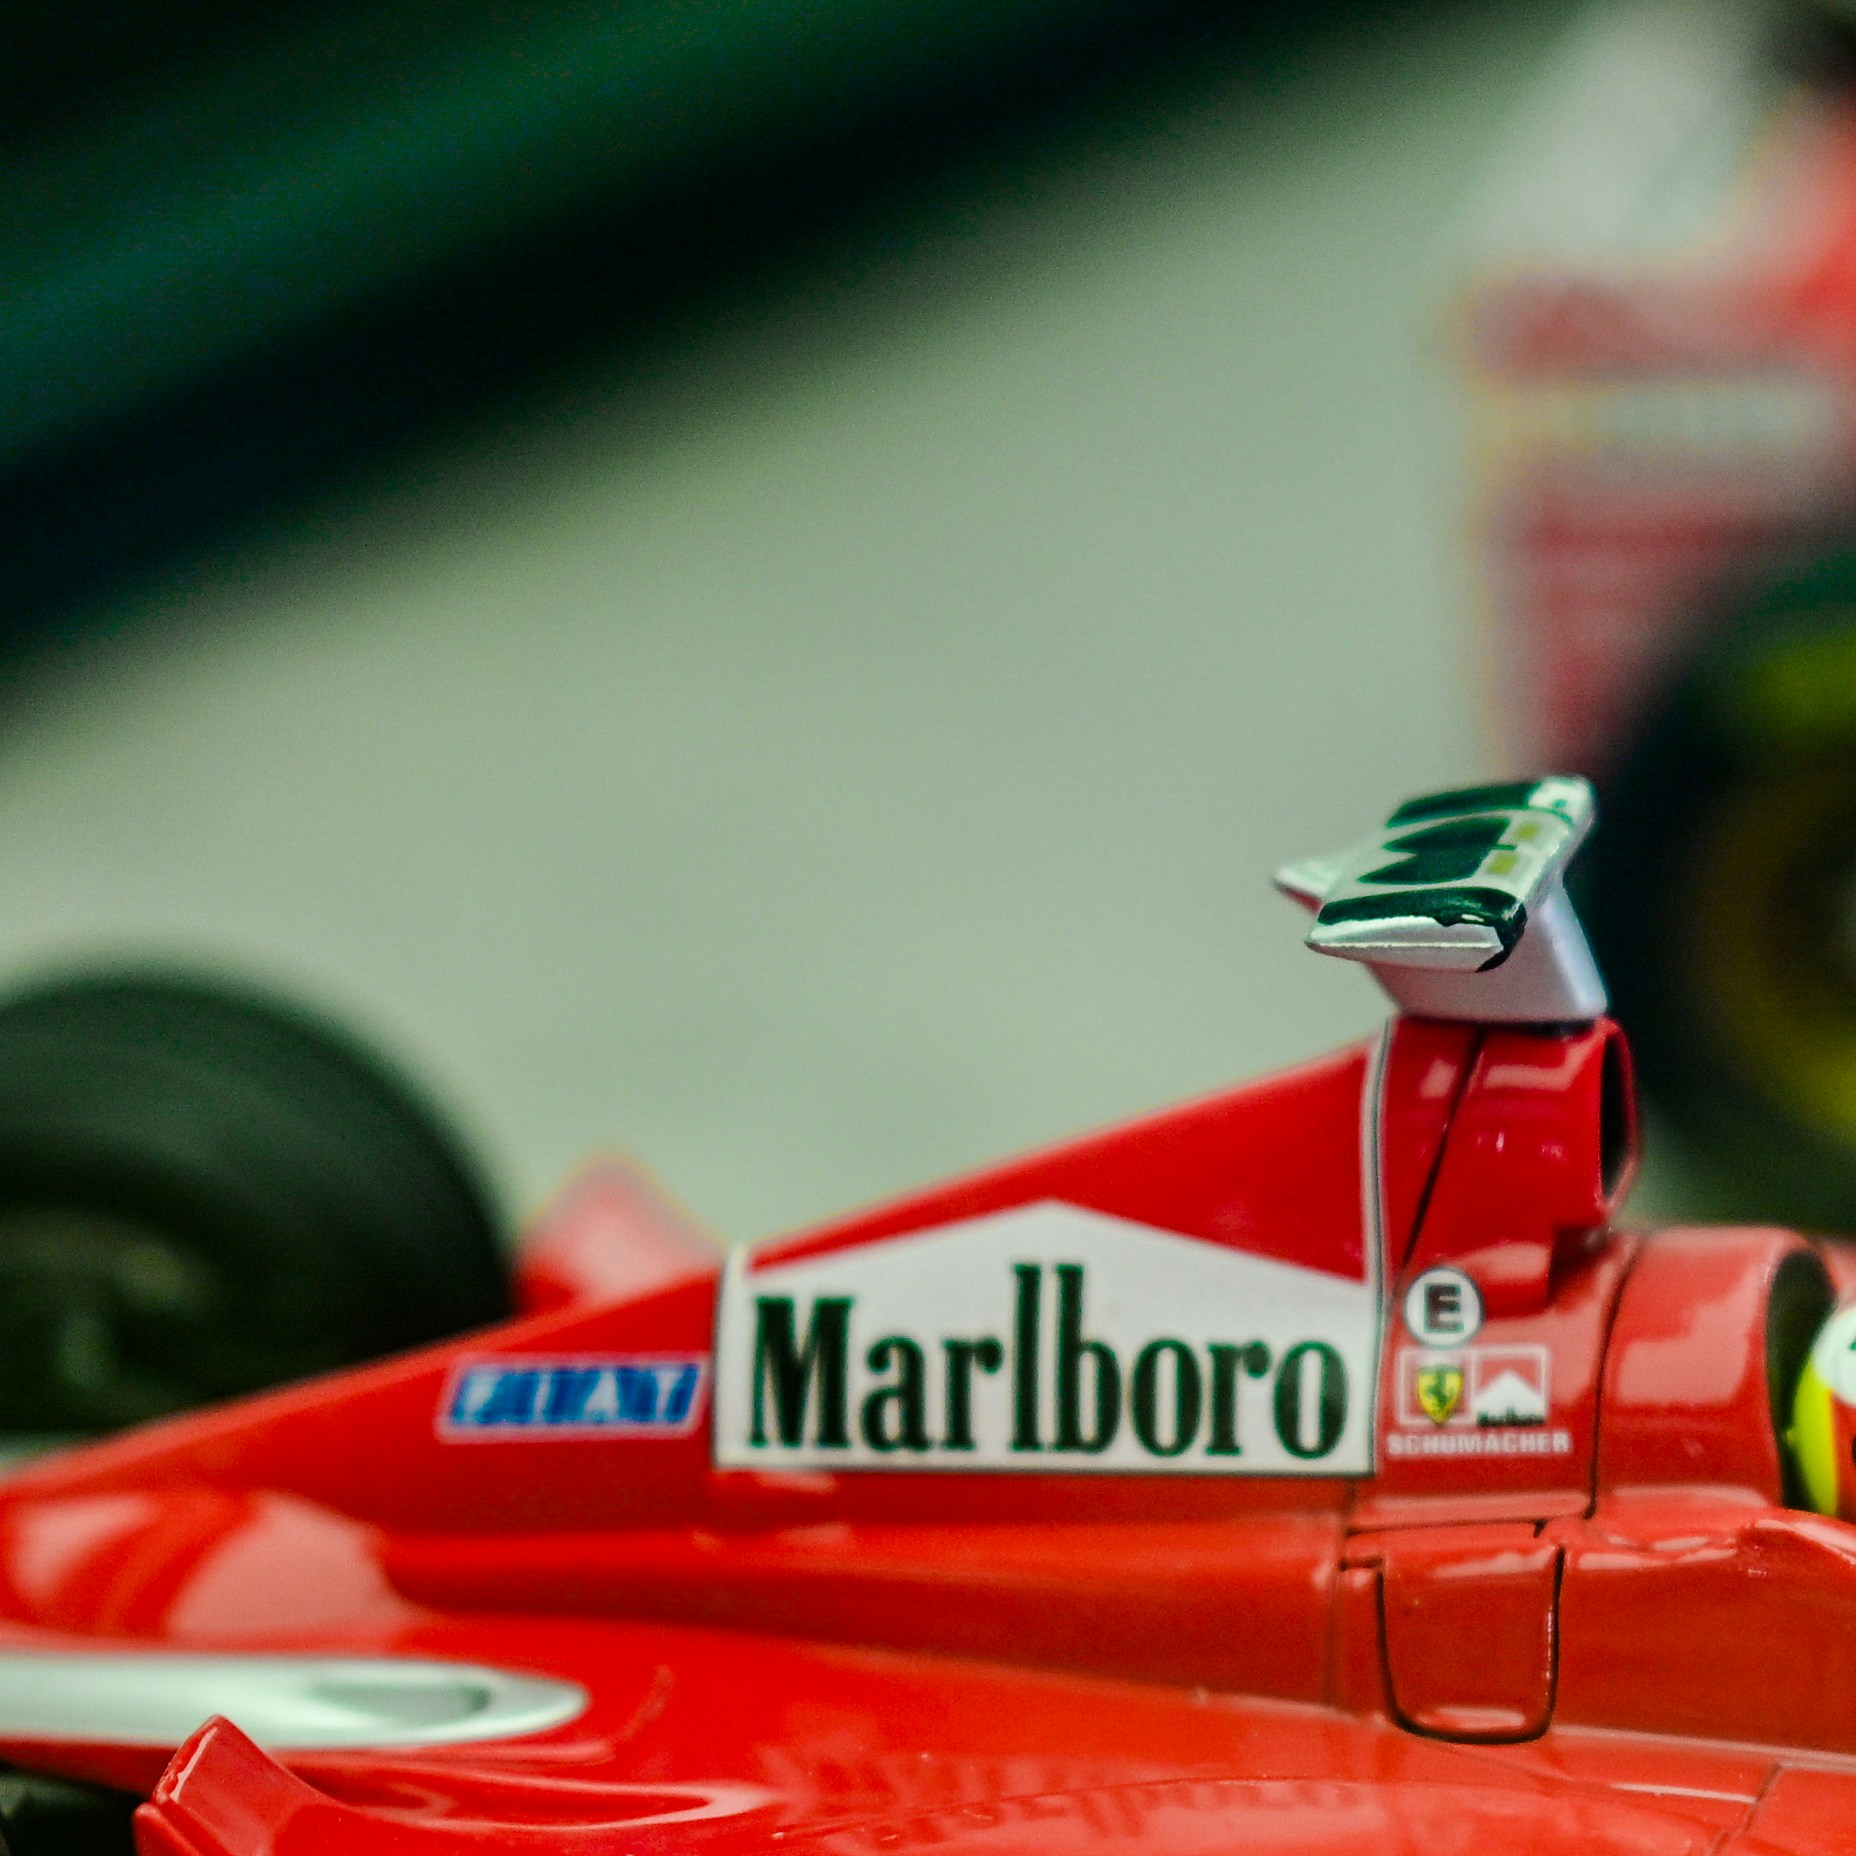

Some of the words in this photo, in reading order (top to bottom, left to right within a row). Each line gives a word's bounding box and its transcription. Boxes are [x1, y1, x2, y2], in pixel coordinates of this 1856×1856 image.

[1423, 1283, 1465, 1333] E
[748, 1262, 1349, 1459] Marlboro
[453, 1365, 693, 1428] FIAT
[1387, 1431, 1572, 1455] SCHUMACHER
